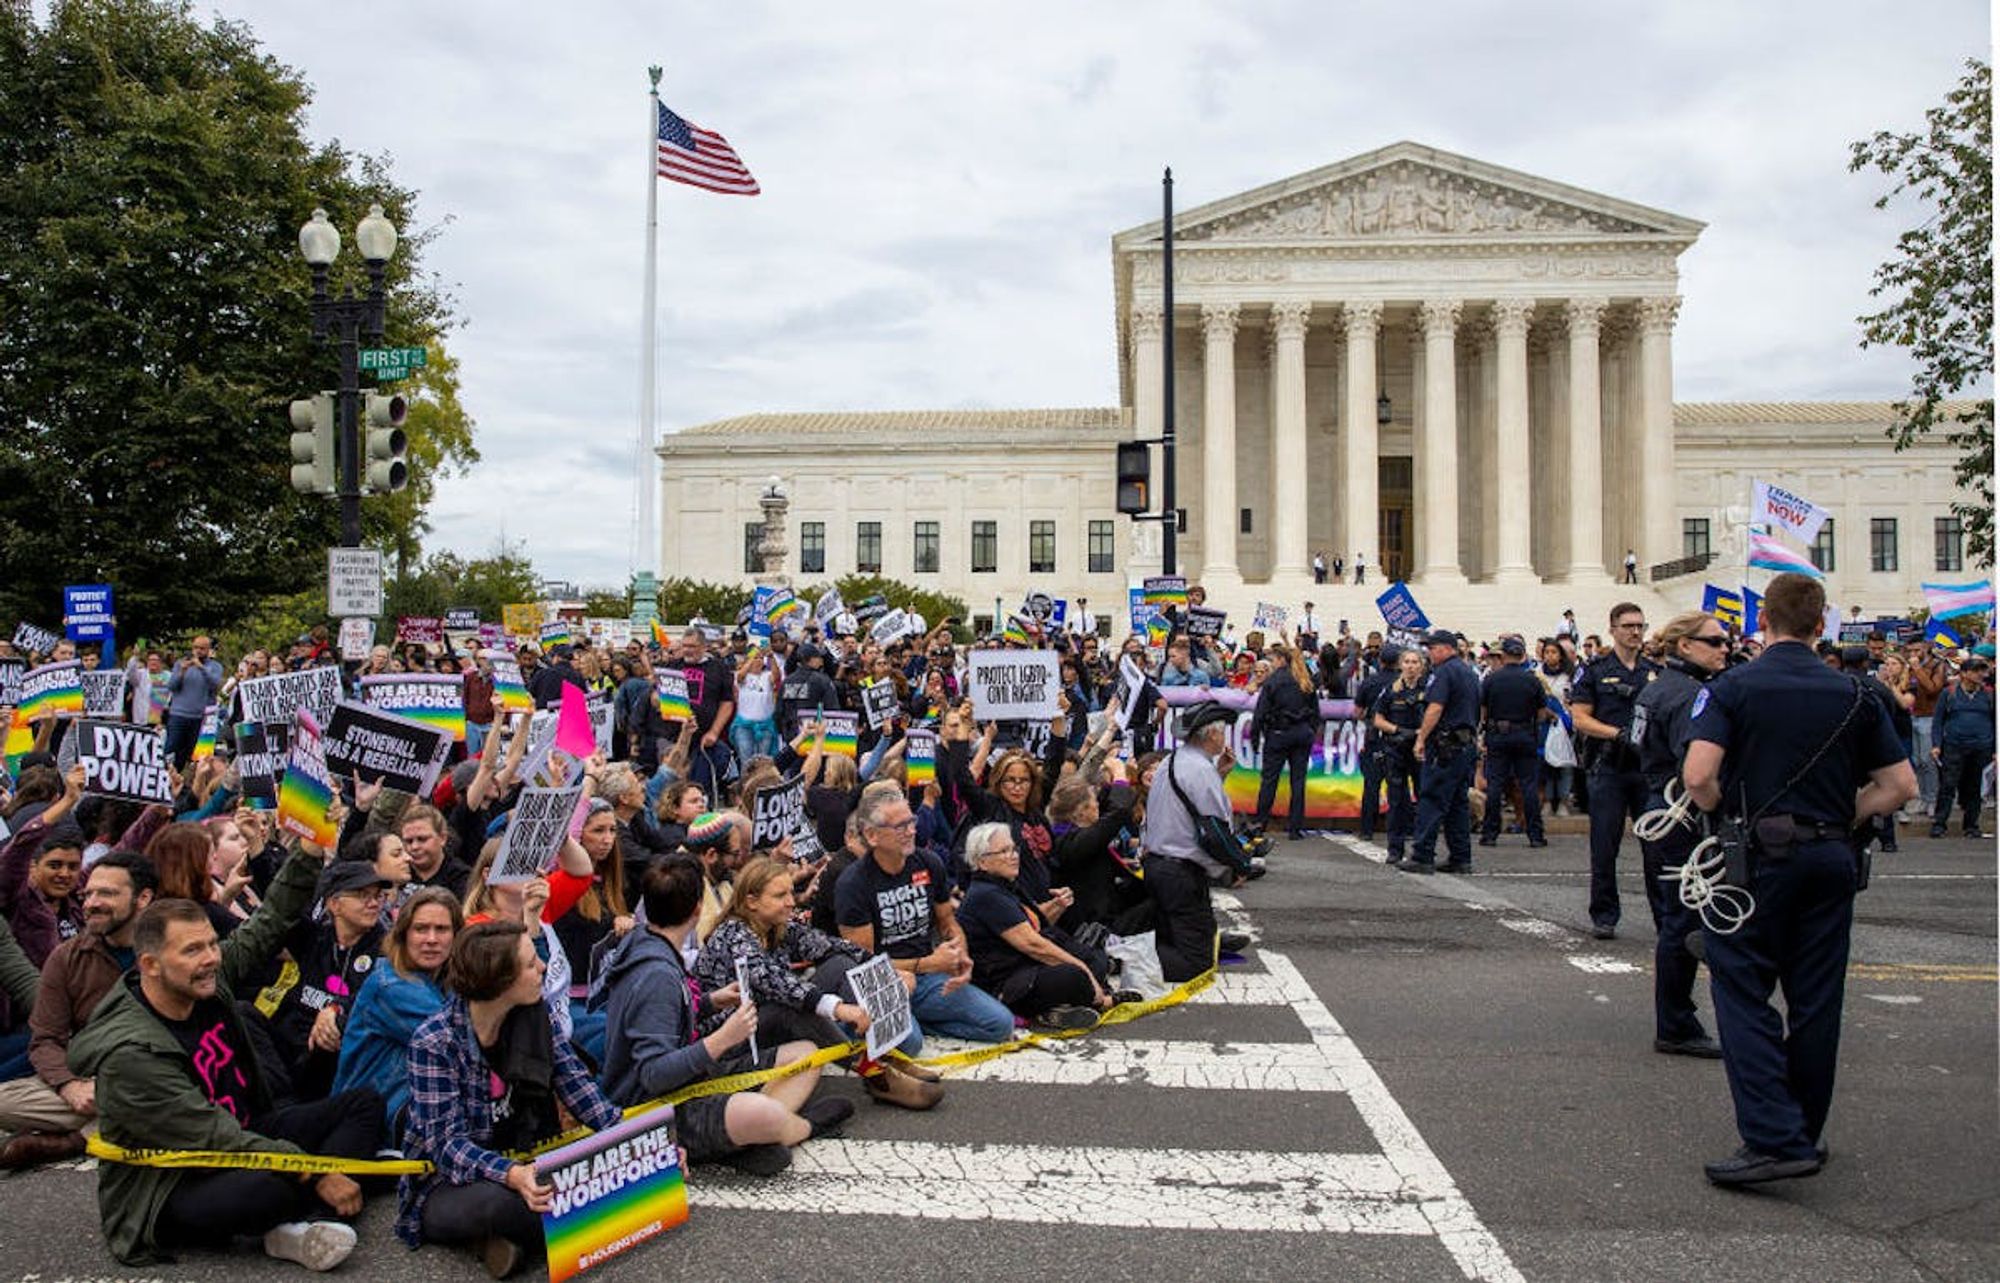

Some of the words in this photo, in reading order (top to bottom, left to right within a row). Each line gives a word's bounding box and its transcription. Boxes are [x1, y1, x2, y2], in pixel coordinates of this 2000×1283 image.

[363, 349, 410, 367] FIRST
[1767, 500, 1806, 526] NOW
[244, 678, 278, 700] TRANS
[279, 673, 317, 697] RIGHTS
[318, 669, 338, 690] ARE
[370, 684, 394, 697] WE
[395, 684, 430, 697] ARE
[431, 684, 457, 697] THE
[976, 665, 1016, 685] PROTECT
[366, 696, 463, 710] WORKFORCE
[988, 685, 1010, 705] CIVIL
[1011, 684, 1046, 704] RIGHTS
[94, 726, 166, 768] DYKE
[324, 736, 351, 760] WAS
[350, 746, 362, 764] A
[361, 749, 428, 780] REBELLION
[345, 725, 417, 760] STONEWALL
[80, 755, 172, 801] POWER
[877, 884, 927, 908] RIGHT
[880, 896, 930, 928] SIDE
[551, 1160, 590, 1192] WE
[591, 1141, 633, 1179] ARE
[631, 1126, 669, 1158] THE
[550, 1143, 679, 1219] WORKFORCE
